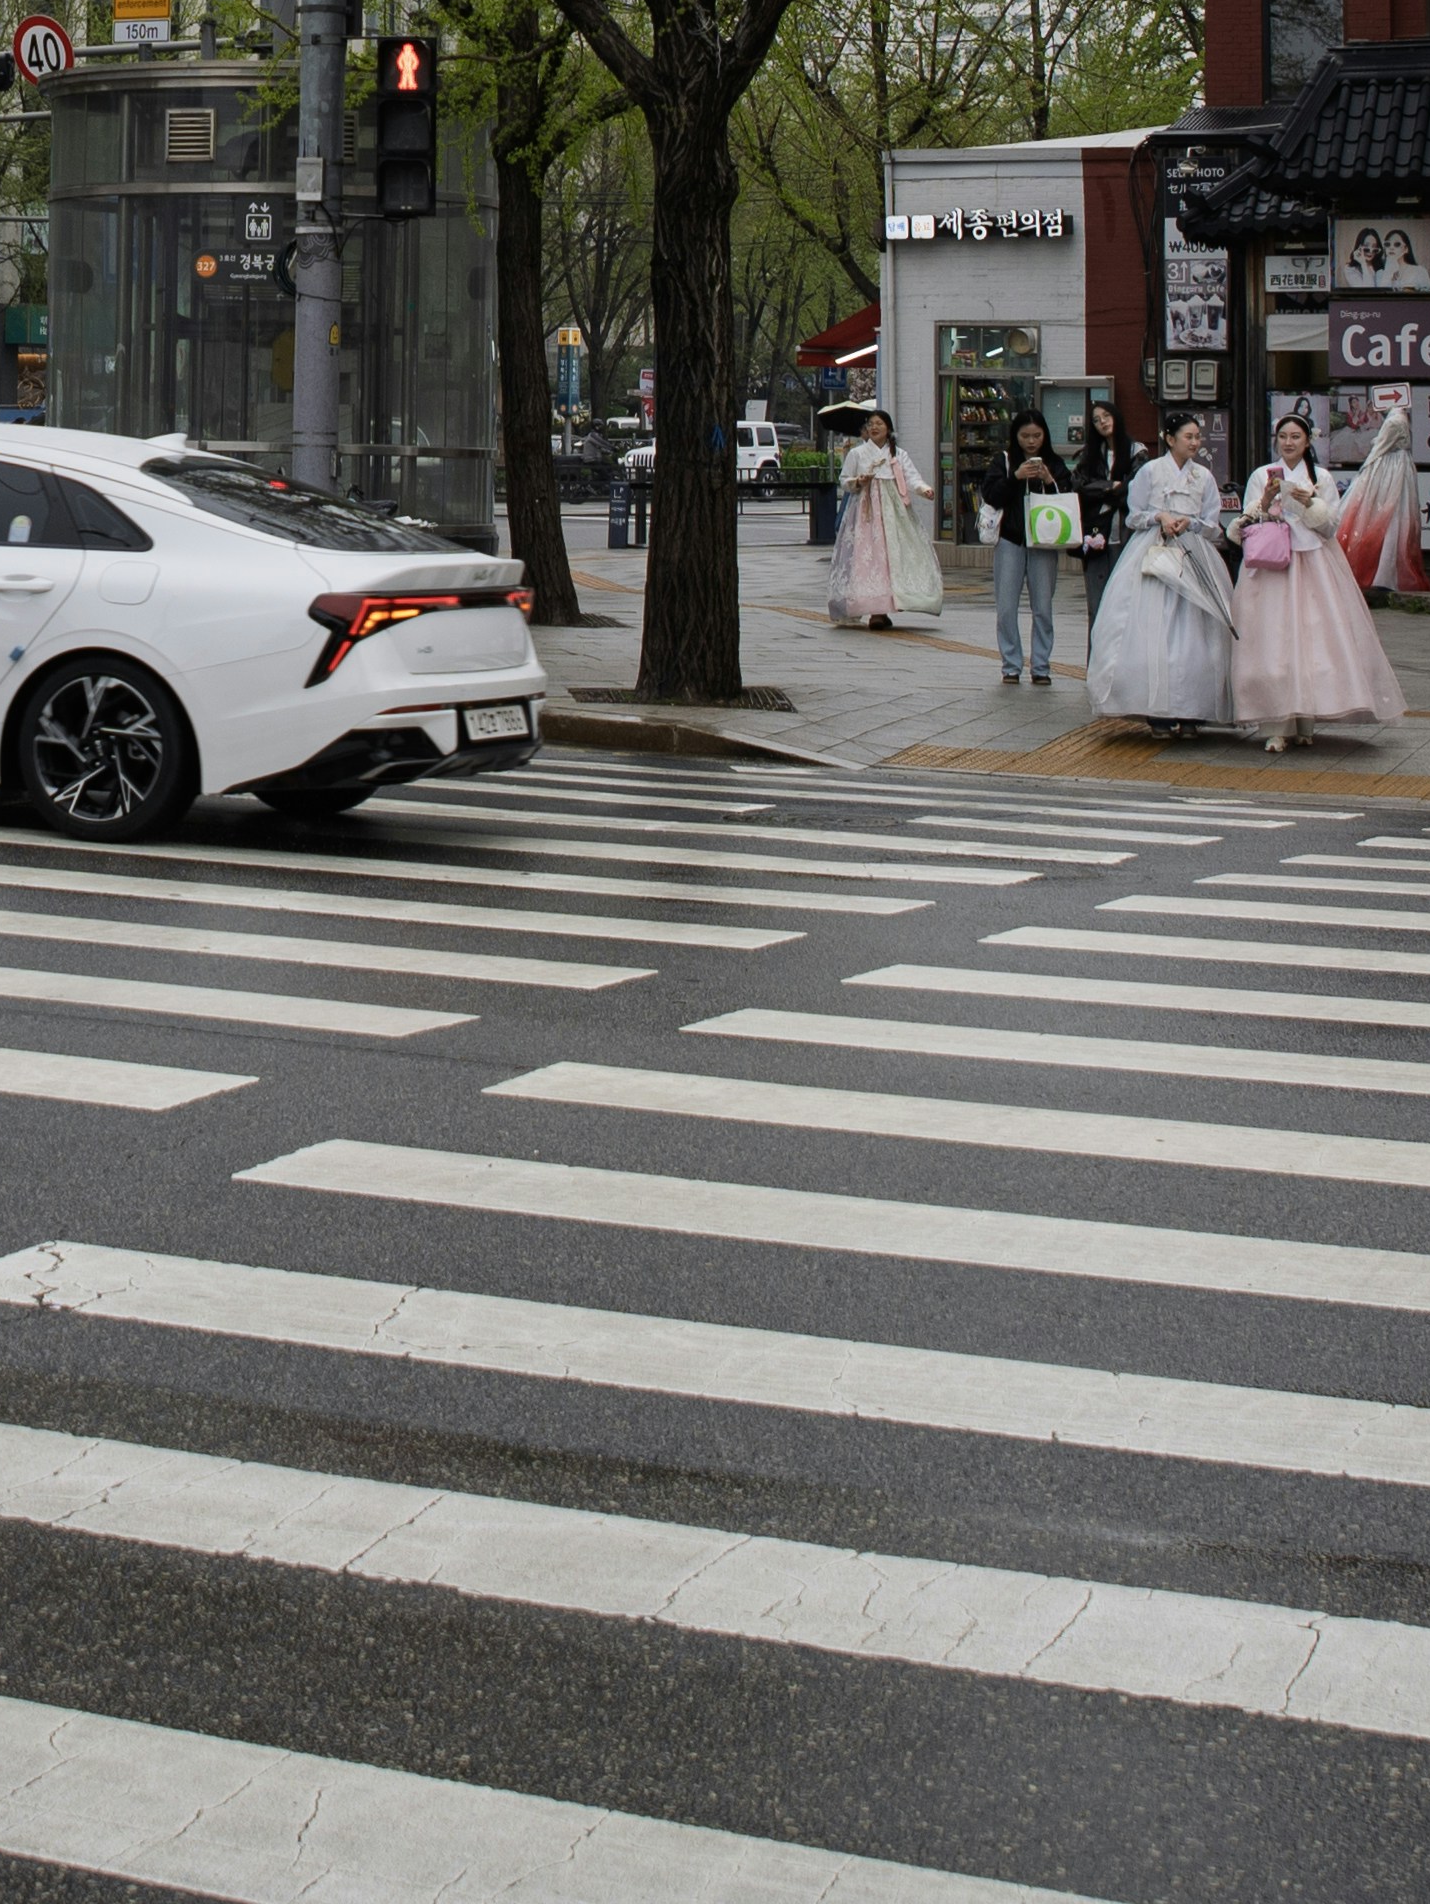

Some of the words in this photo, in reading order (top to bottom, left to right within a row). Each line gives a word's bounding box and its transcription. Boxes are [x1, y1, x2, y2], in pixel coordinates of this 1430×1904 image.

[125, 23, 159, 40] 150m
[27, 32, 61, 73] 40
[939, 207, 994, 241] 세종
[995, 208, 1064, 239] 편의점
[196, 261, 217, 272] 327
[239, 253, 275, 271] 경복궁
[1206, 285, 1225, 293] Cafe
